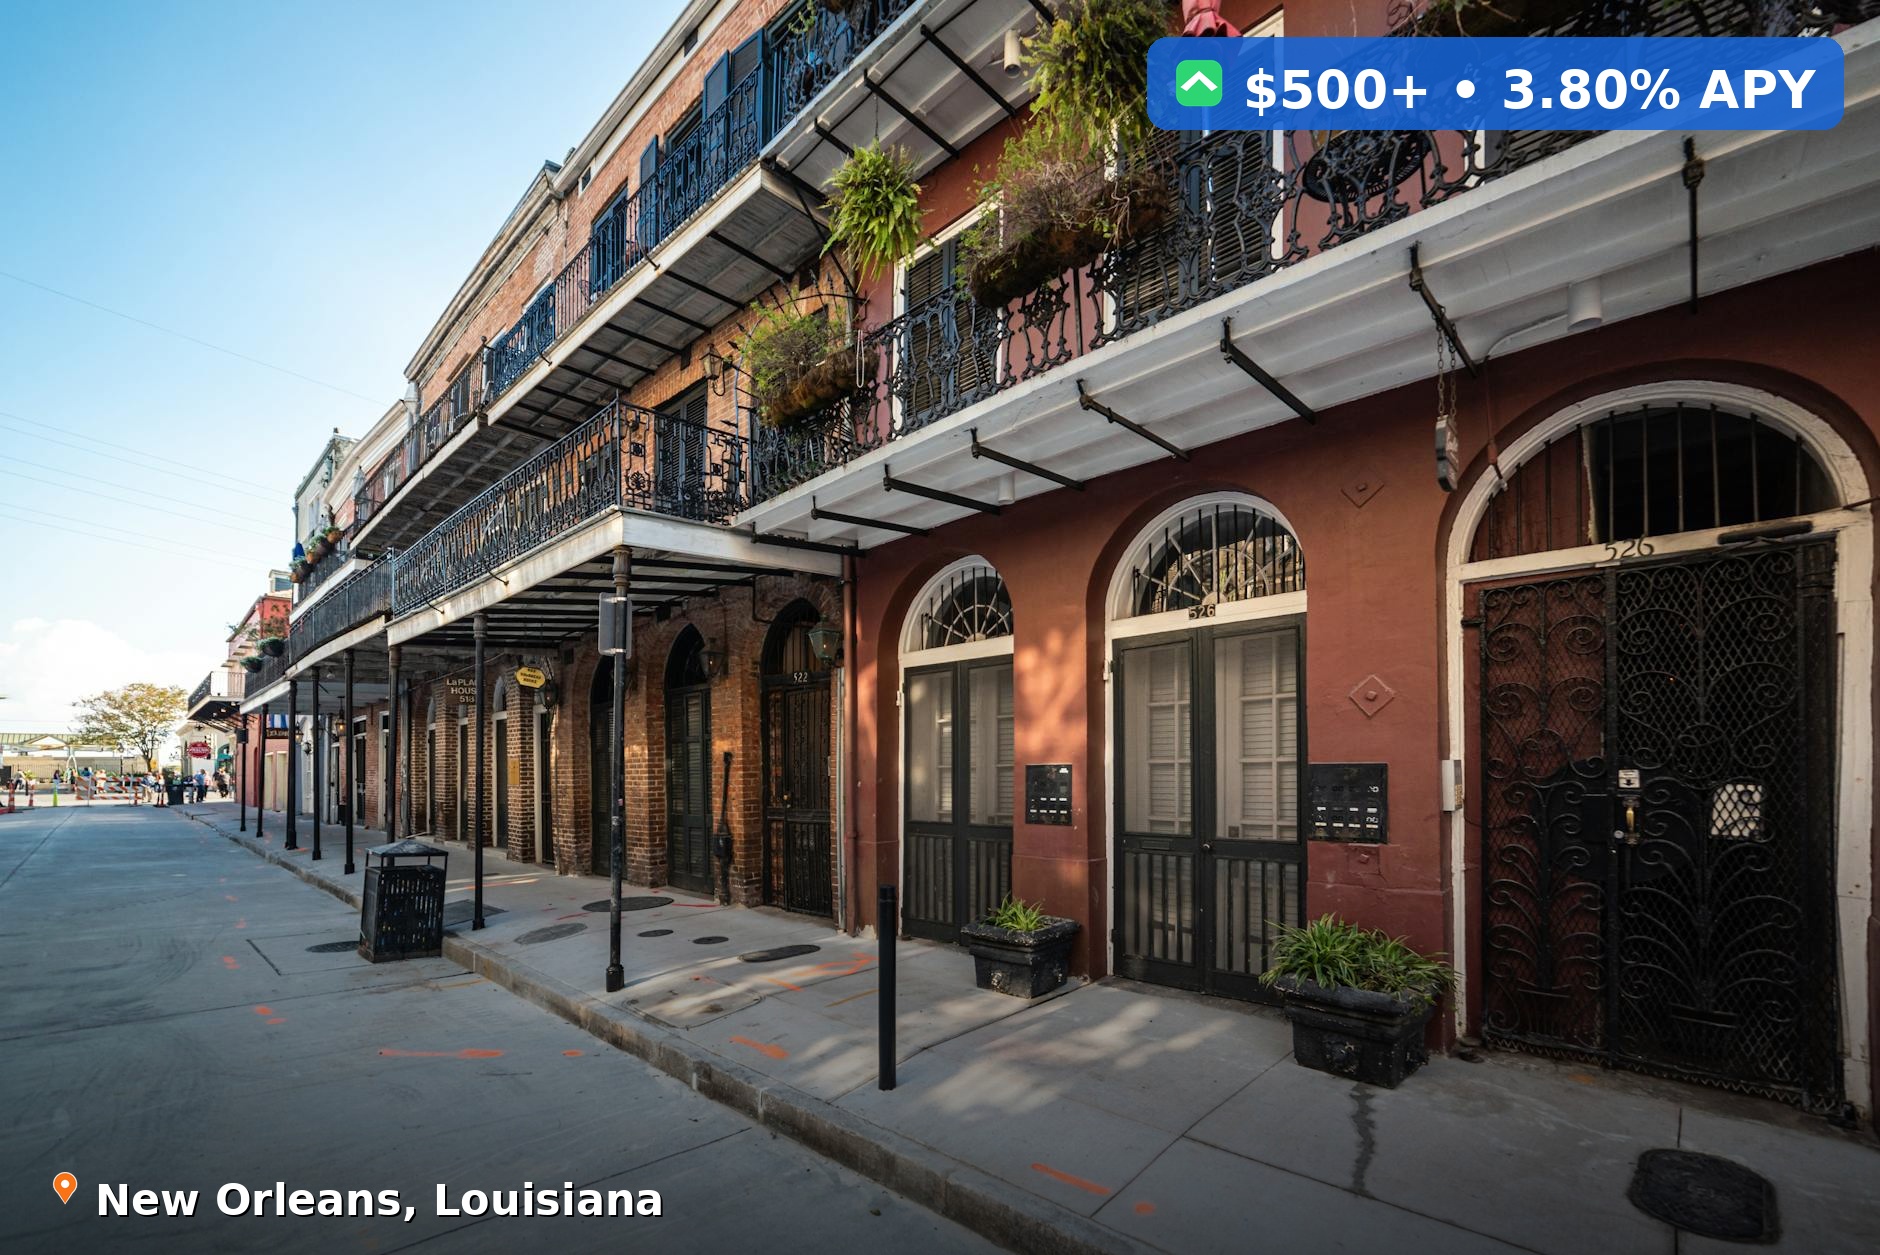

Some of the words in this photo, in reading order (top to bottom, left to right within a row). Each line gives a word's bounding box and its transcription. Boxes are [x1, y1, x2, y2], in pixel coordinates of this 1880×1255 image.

[1602, 534, 1654, 563] 526
[1188, 604, 1216, 619] 526
[793, 671, 808, 683] 522
[450, 687, 477, 695] HOUS
